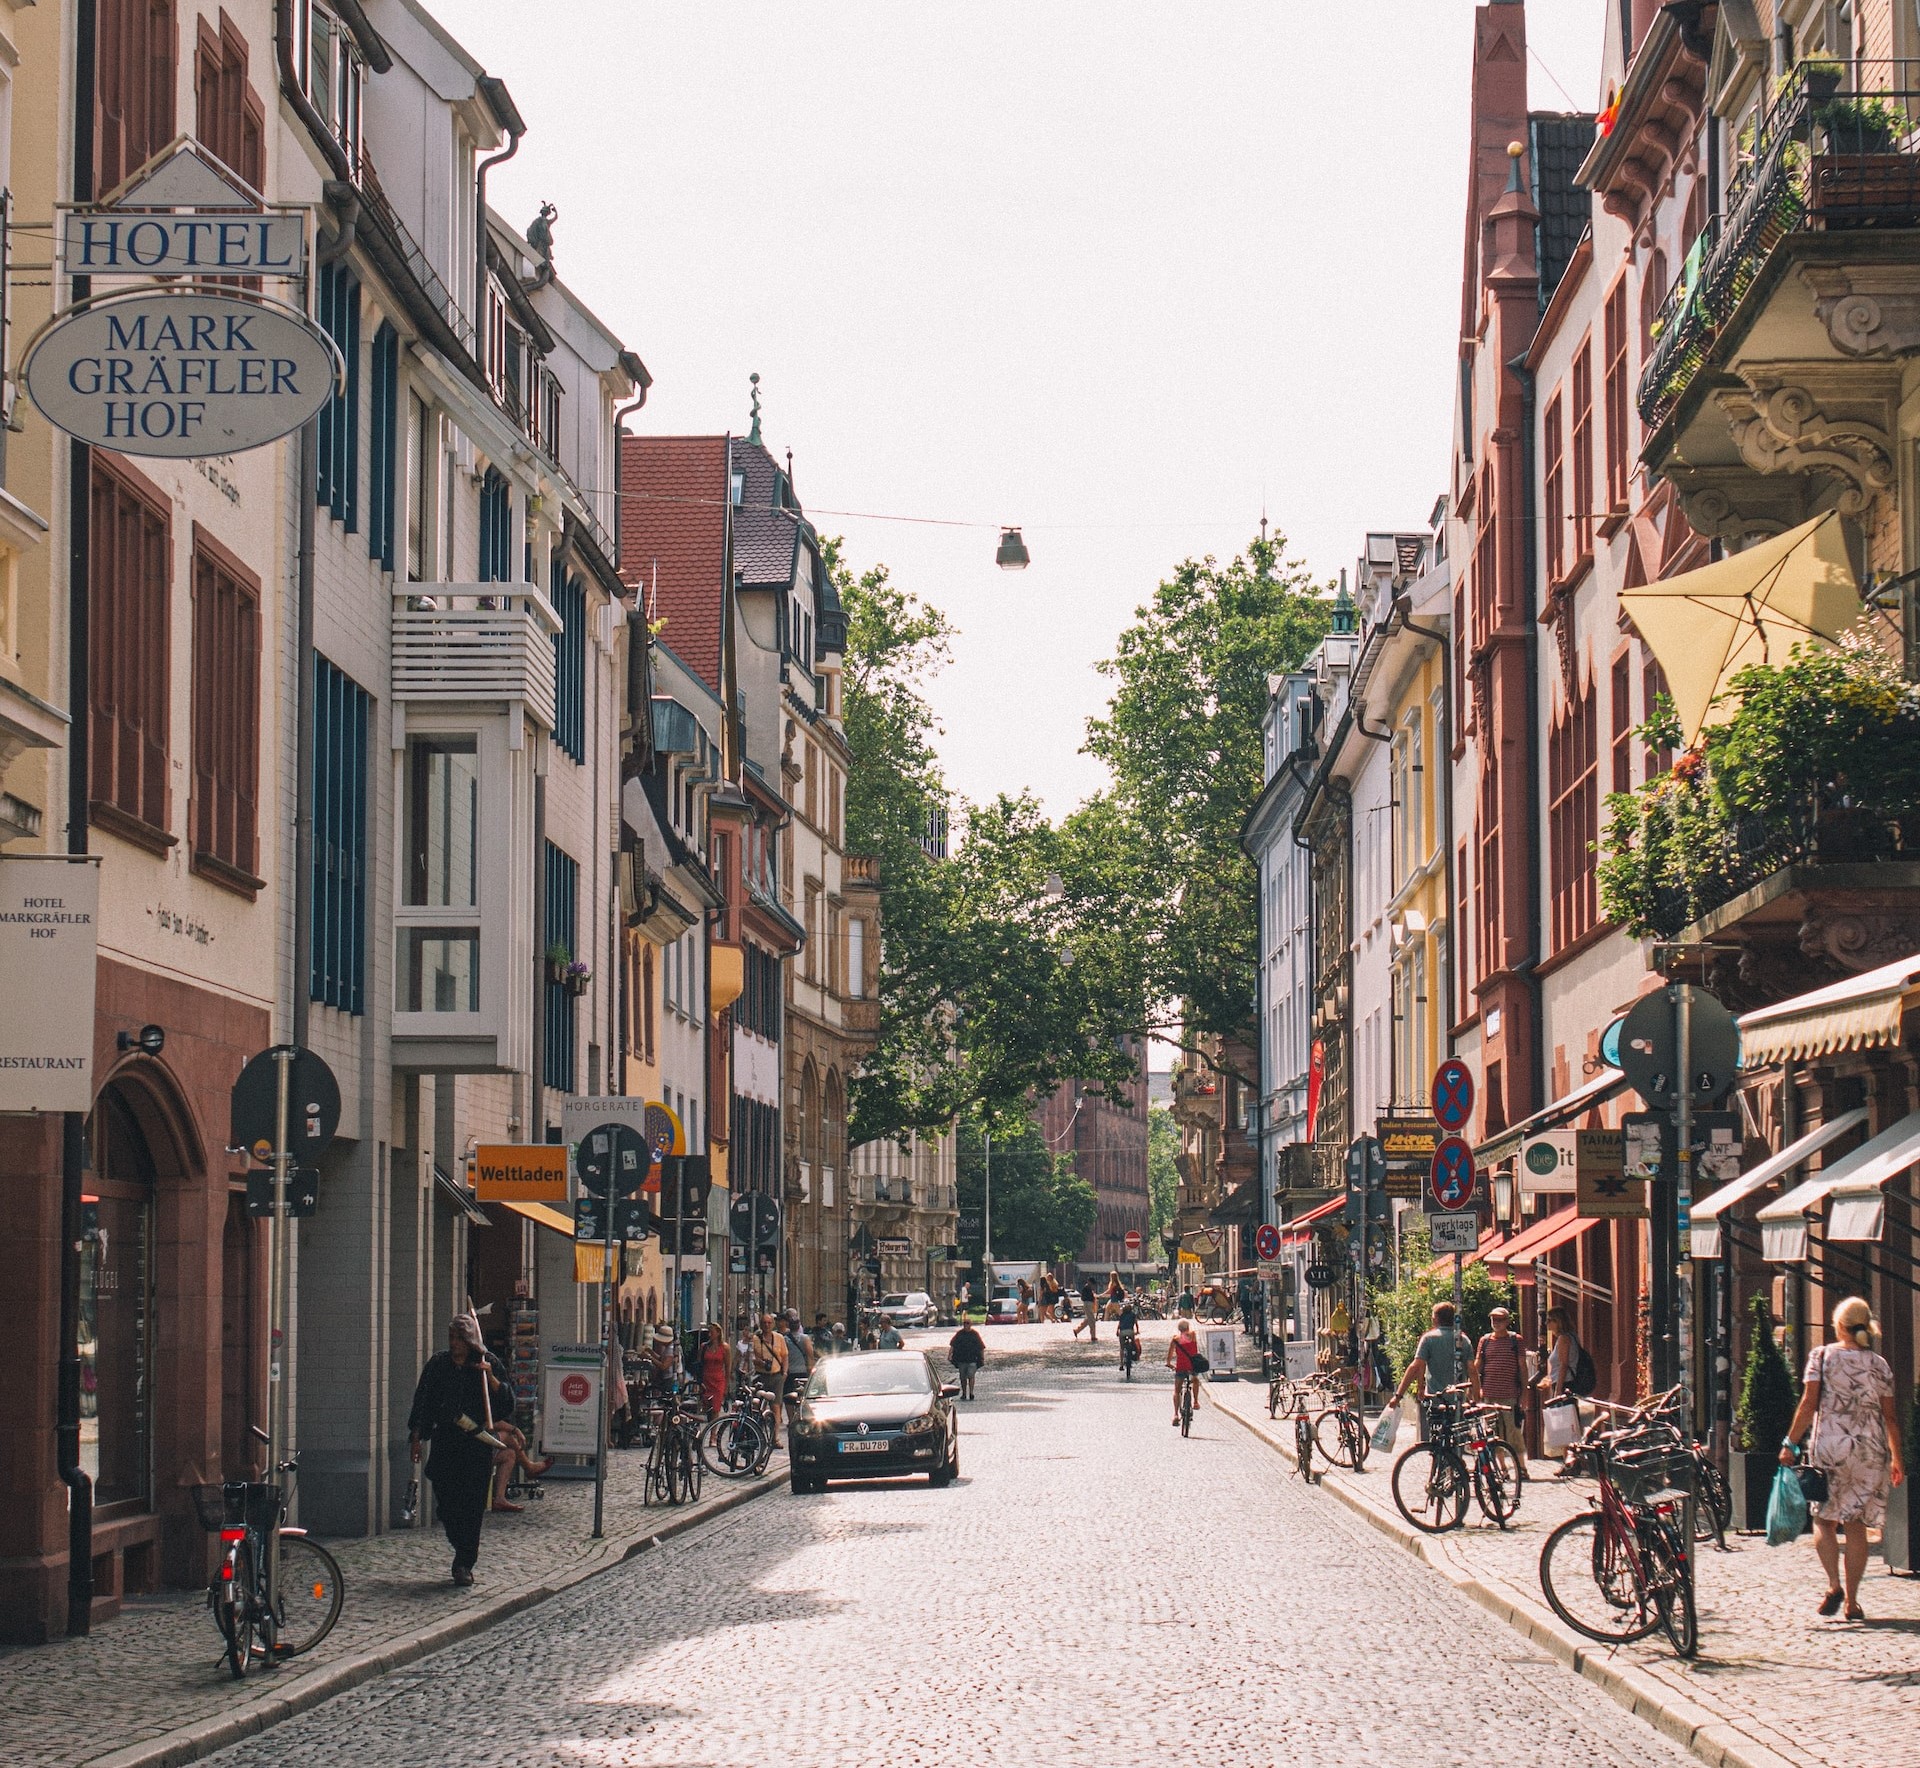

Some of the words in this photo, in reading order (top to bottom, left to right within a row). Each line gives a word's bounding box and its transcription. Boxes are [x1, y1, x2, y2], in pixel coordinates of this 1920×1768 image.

[79, 222, 292, 266] HOTEL
[105, 315, 259, 352] MARK
[68, 355, 302, 395] GRÄFLER
[103, 402, 206, 438] HOF
[23, 897, 66, 909] HOTEL
[0, 911, 91, 924] MARKGRÄFLER
[31, 928, 57, 938] HOF
[0, 1057, 86, 1069] ESTAURANT
[480, 1165, 564, 1182] Weltladen
[1434, 1219, 1474, 1232] werktags
